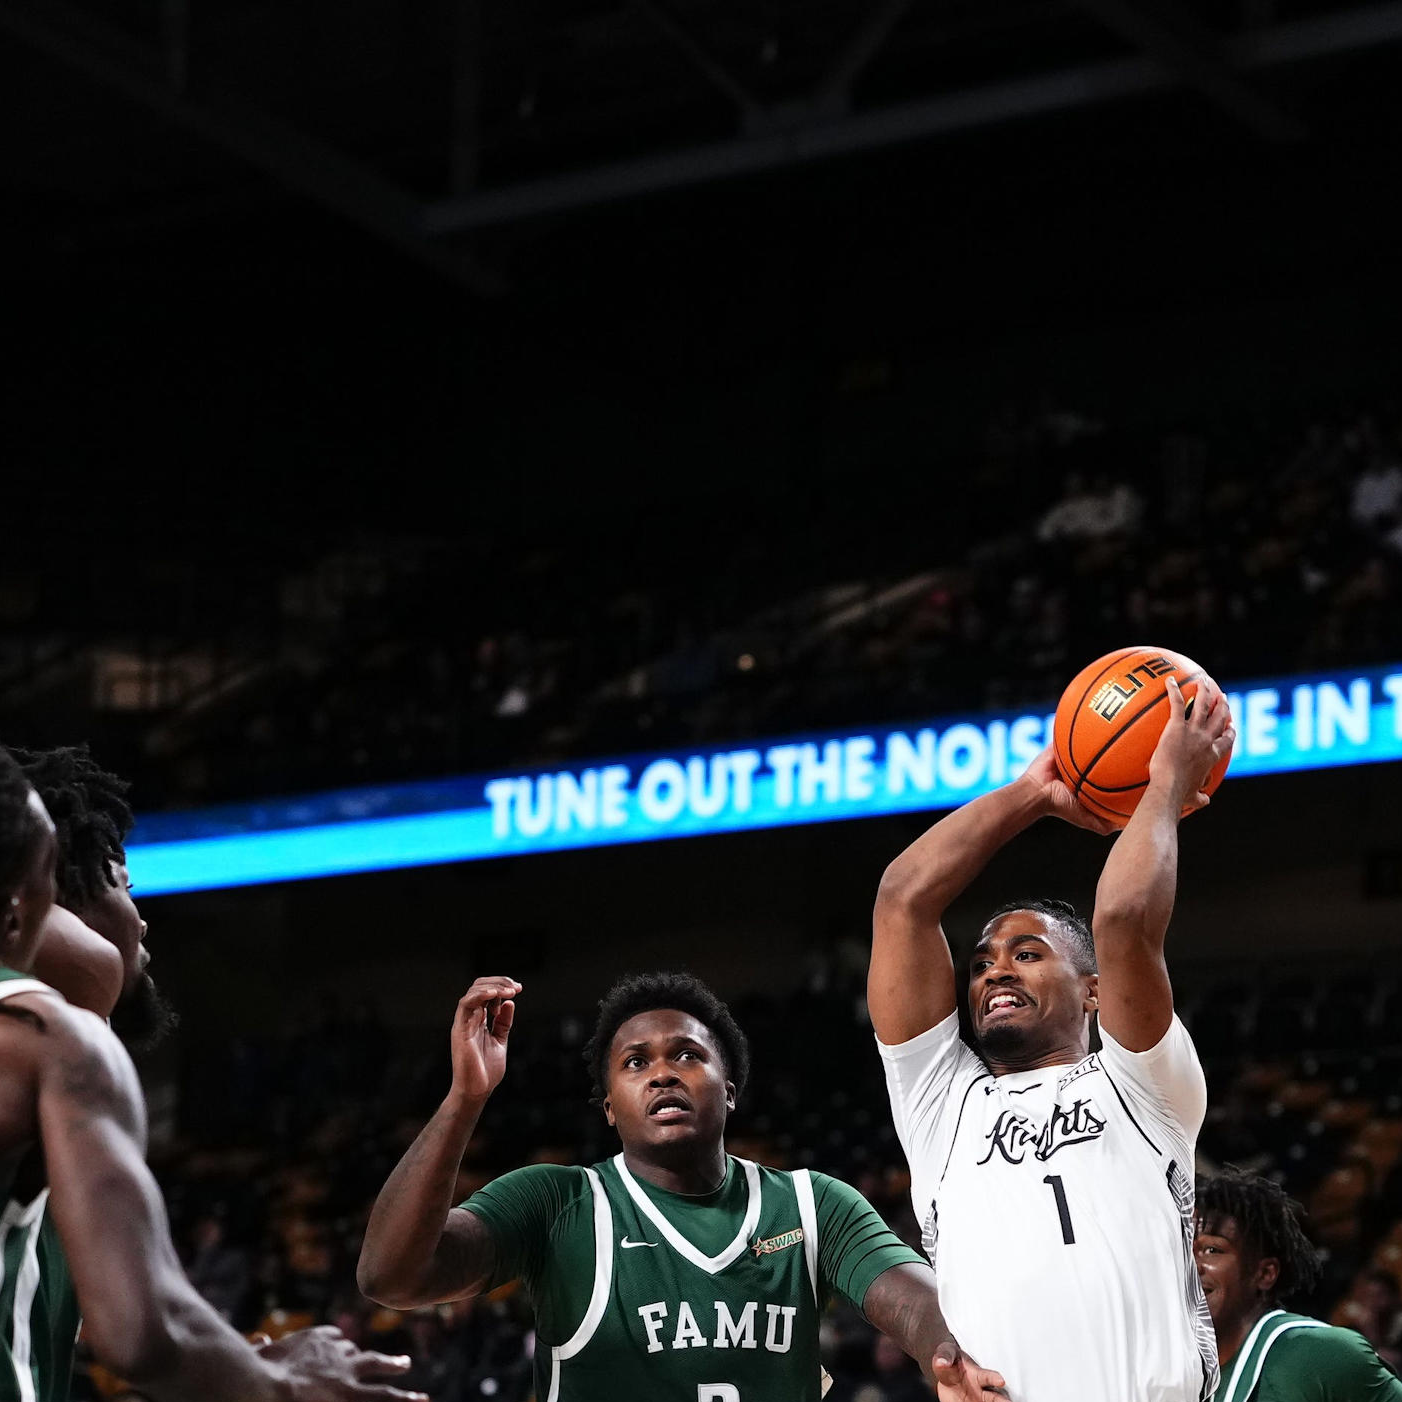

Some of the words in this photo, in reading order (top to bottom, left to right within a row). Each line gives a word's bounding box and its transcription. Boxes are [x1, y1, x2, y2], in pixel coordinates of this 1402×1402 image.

[1094, 656, 1177, 724] ELITE
[486, 765, 628, 838] TUNE
[639, 751, 760, 819] OUT
[766, 736, 875, 809] THE
[1293, 677, 1371, 751] IN
[977, 1099, 1107, 1165] Knights
[766, 1229, 803, 1251] SWAC
[1043, 1175, 1076, 1245] 1
[638, 1301, 797, 1354] FAMU
